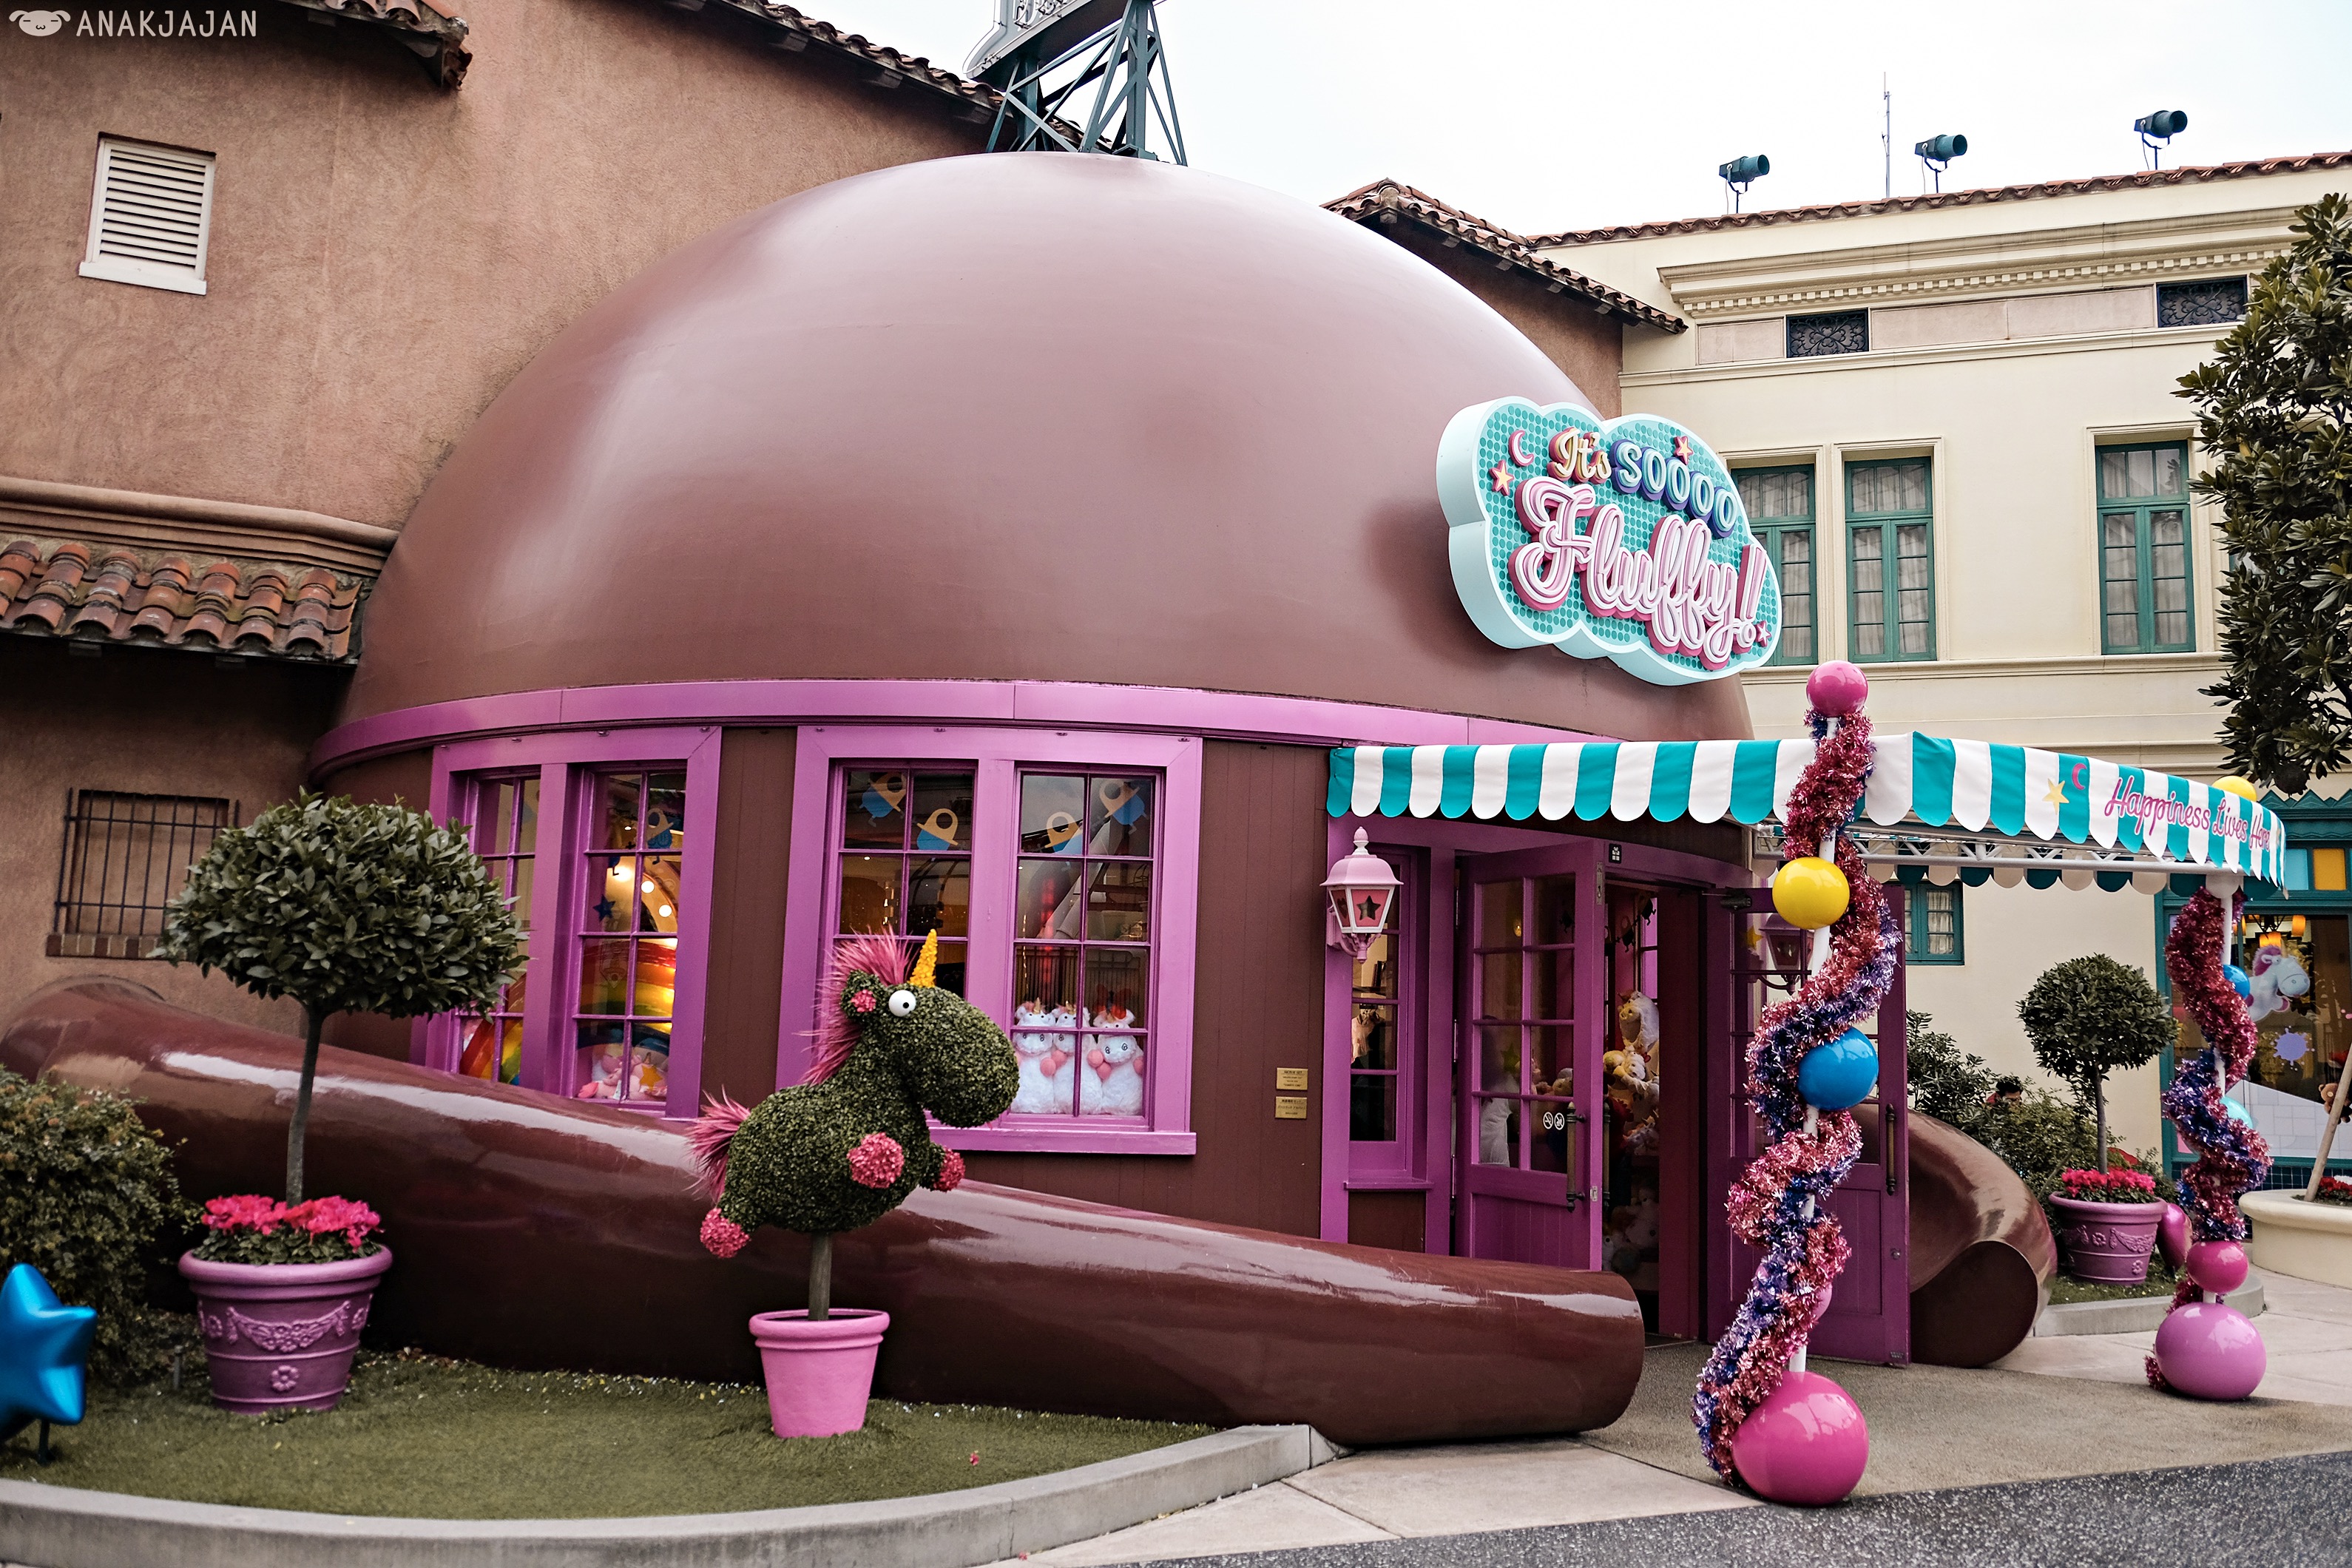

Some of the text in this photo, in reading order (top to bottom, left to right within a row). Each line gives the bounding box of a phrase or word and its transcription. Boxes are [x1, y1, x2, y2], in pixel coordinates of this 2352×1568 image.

[1548, 427, 1612, 484] It's
[1508, 476, 1768, 672] Fluffy!
[2104, 775, 2271, 852] Happiness Lives Here
